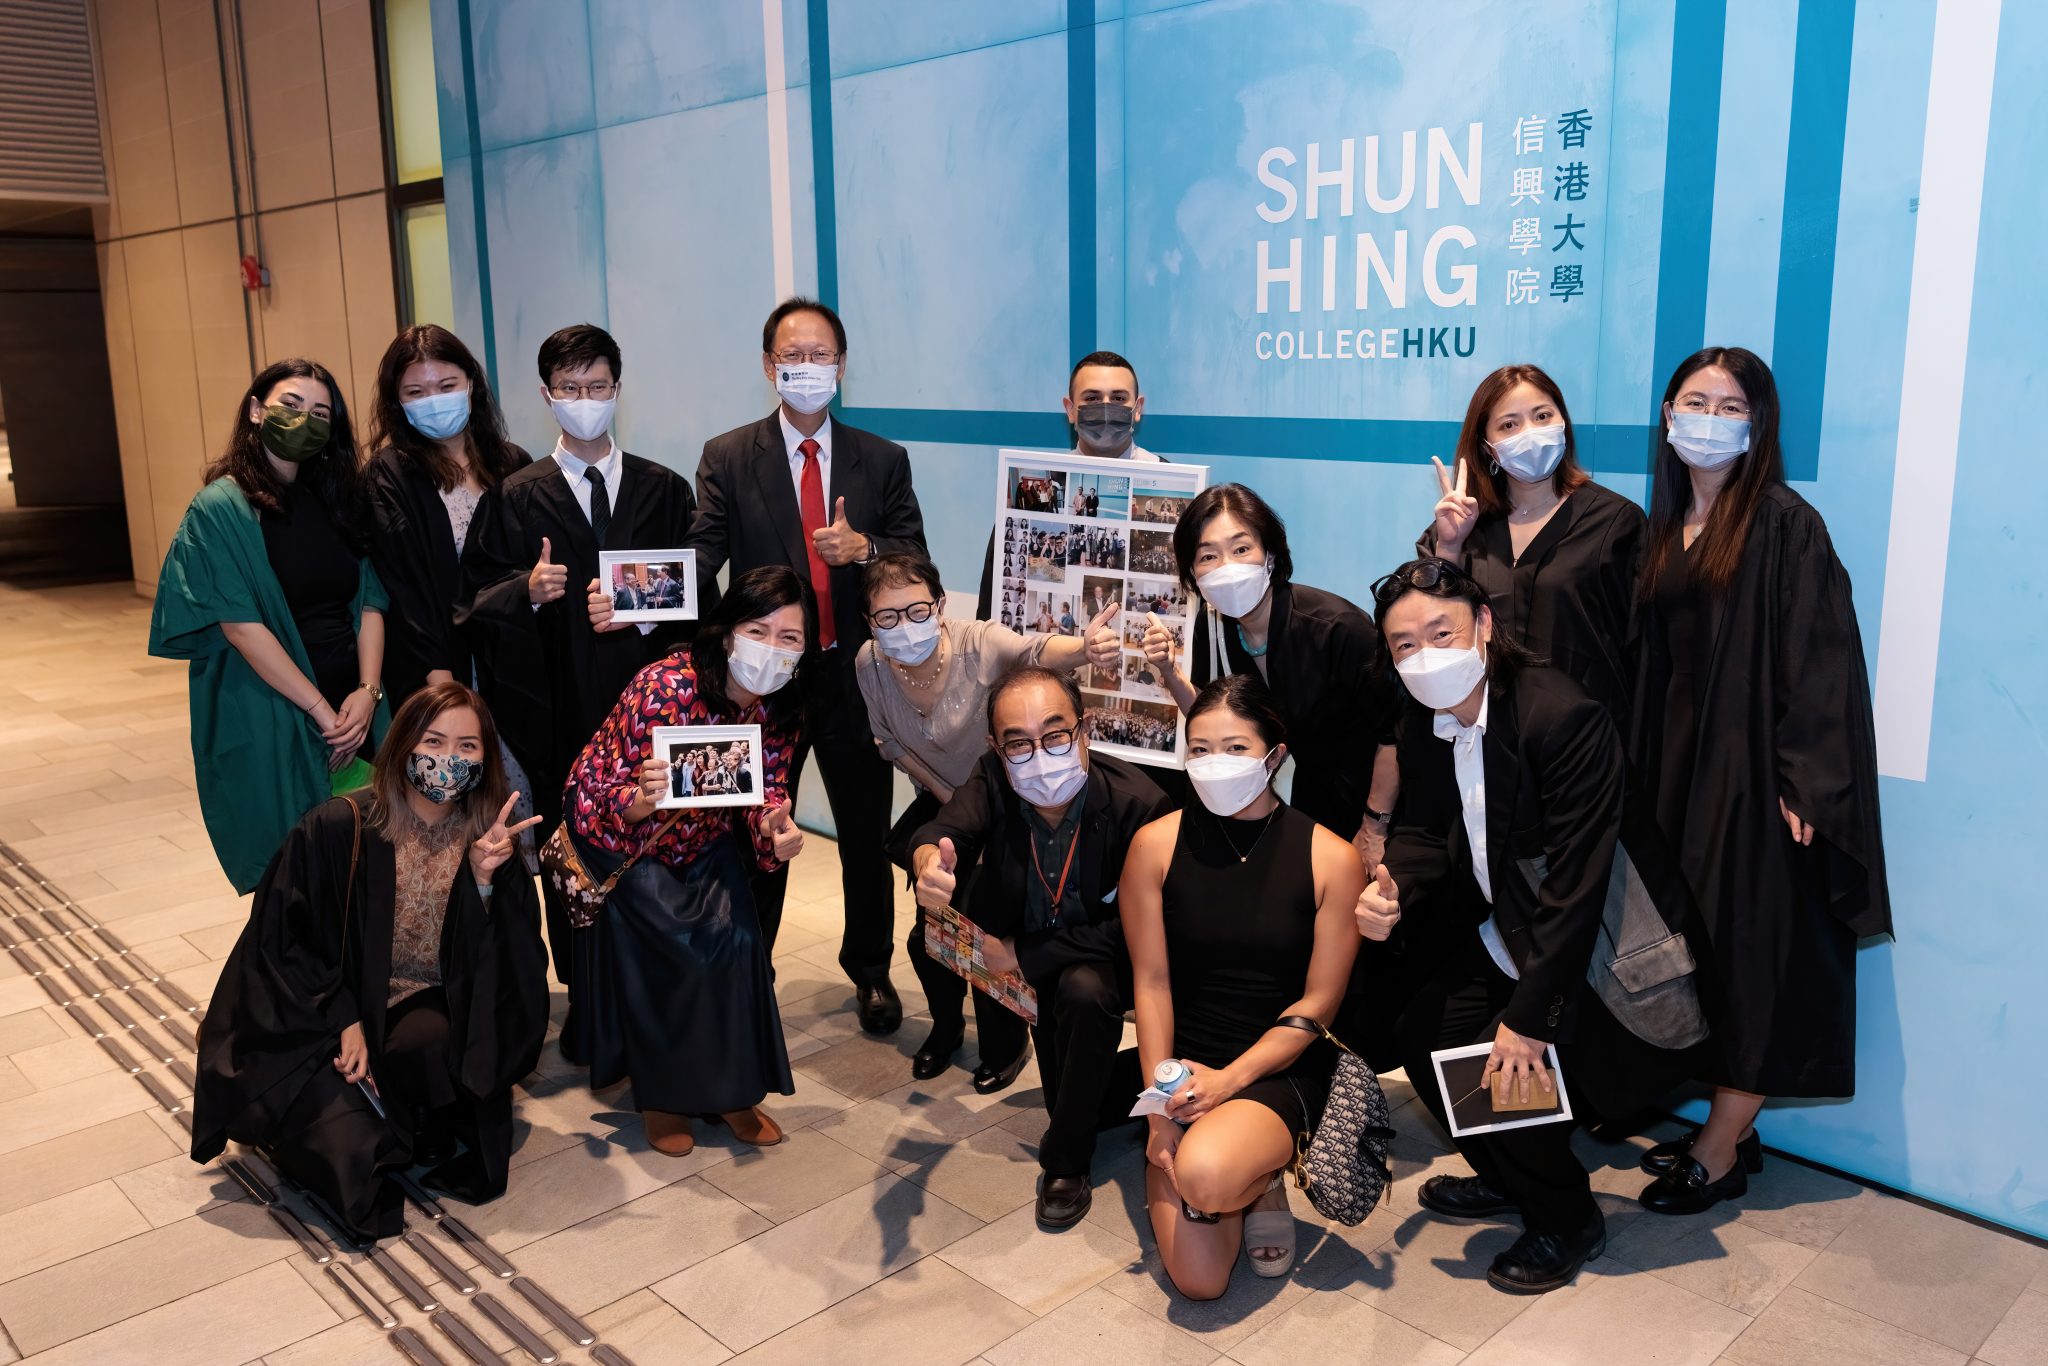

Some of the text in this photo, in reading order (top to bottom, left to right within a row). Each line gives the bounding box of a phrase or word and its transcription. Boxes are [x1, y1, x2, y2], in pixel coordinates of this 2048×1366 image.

[1256, 122, 1483, 223] SHUN
[1506, 115, 1546, 305] 信興學院
[1550, 109, 1592, 303] 香港大學
[1256, 225, 1477, 313] HING
